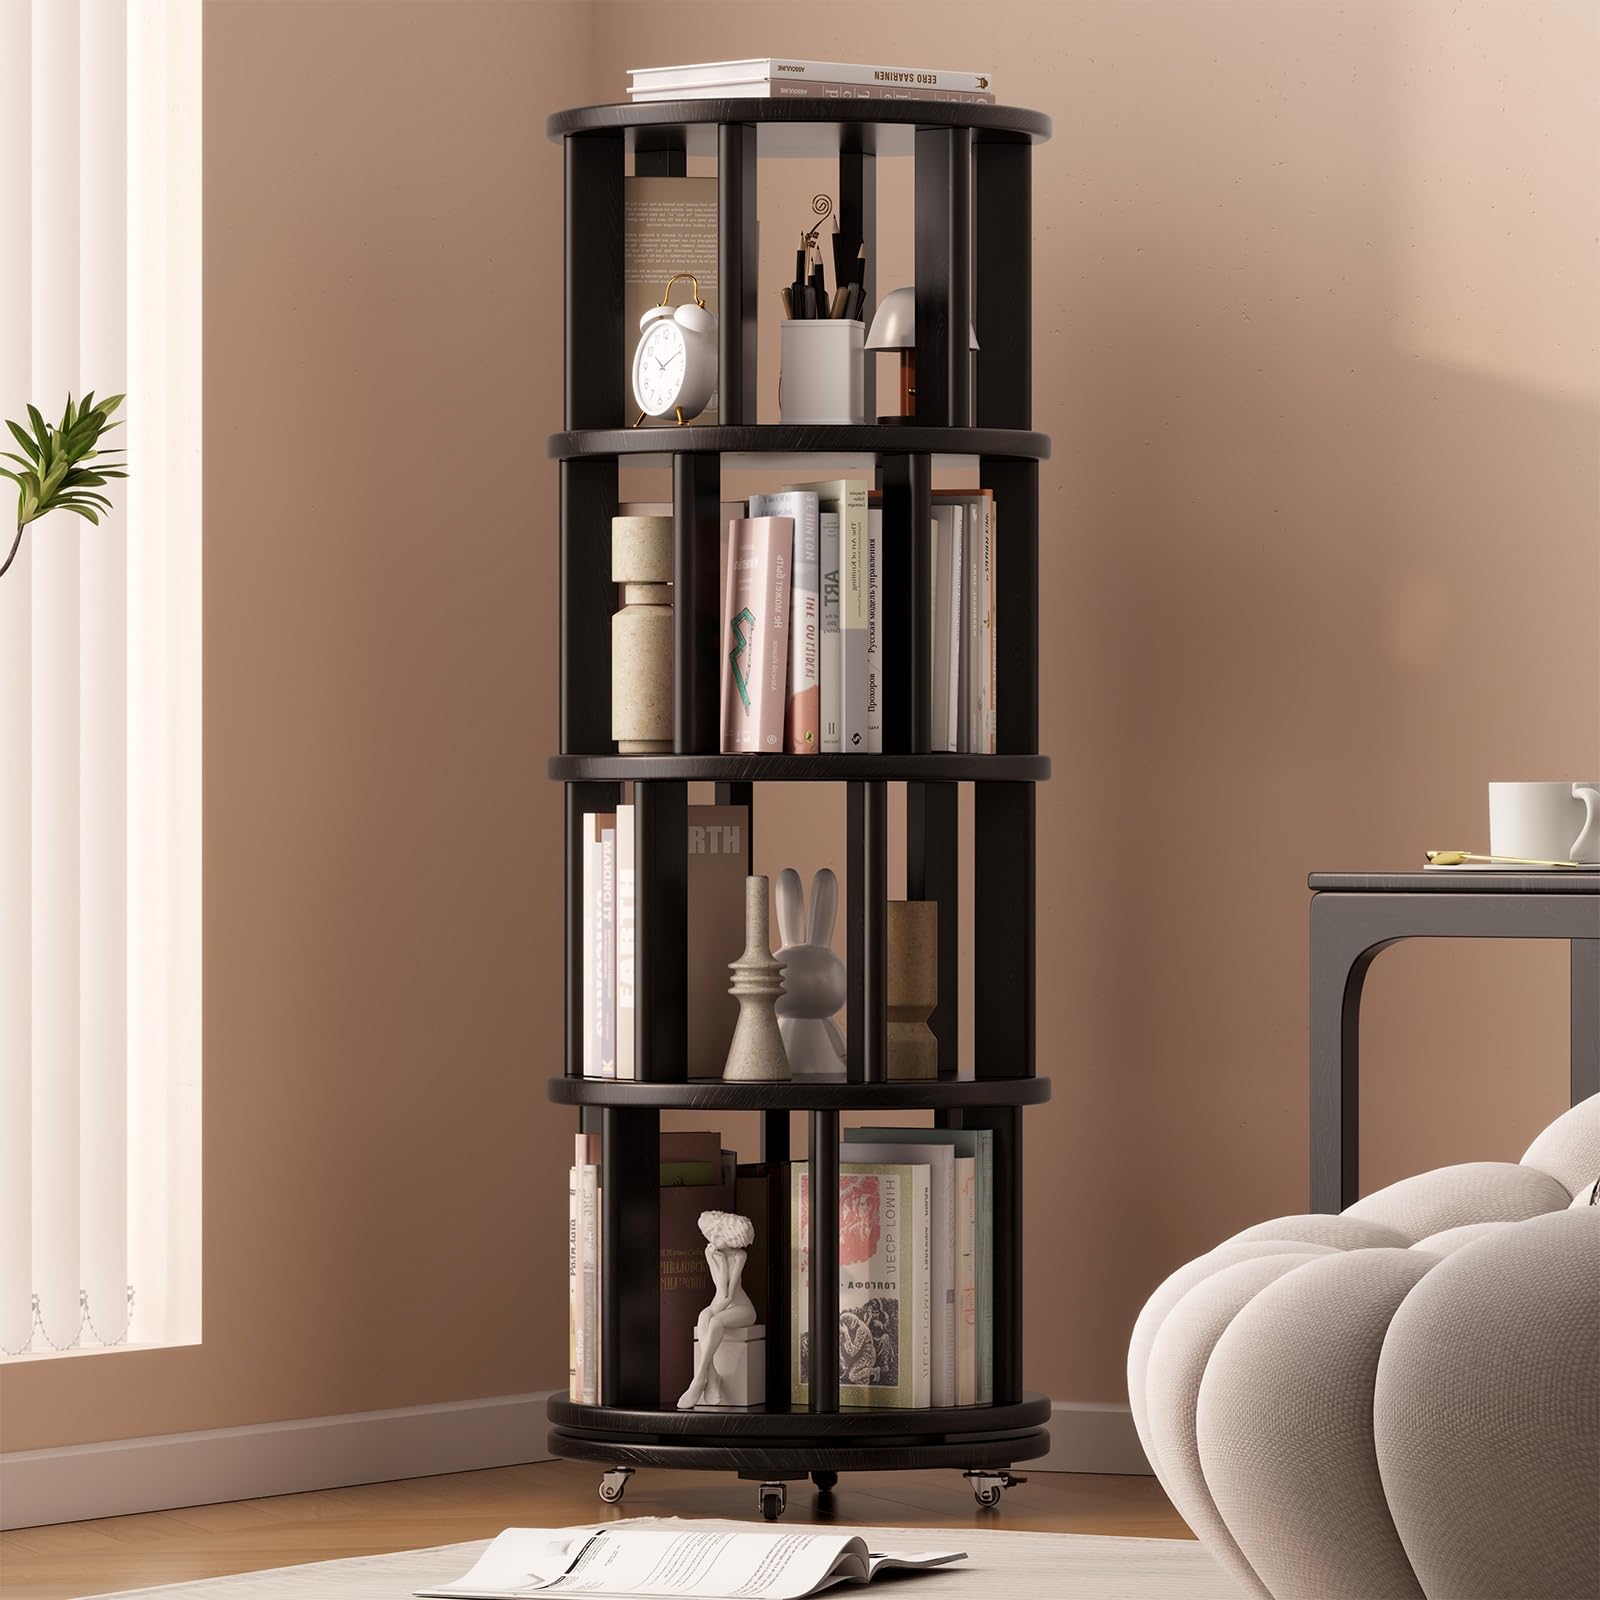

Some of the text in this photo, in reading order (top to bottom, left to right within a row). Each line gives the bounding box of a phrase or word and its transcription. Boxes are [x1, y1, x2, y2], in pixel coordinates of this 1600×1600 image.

[777, 65, 805, 73] ASSOULINE
[874, 71, 937, 84] EERO SAARINEN
[654, 334, 660, 345] 11
[663, 328, 670, 340] 12
[869, 538, 878, 588] управления
[805, 596, 816, 680] THE OUTSIDERS
[868, 620, 878, 654] Русская
[868, 673, 878, 712] Прохоров
[688, 826, 740, 854] RTH
[603, 840, 612, 902] MAKING
[603, 906, 612, 922] IT
